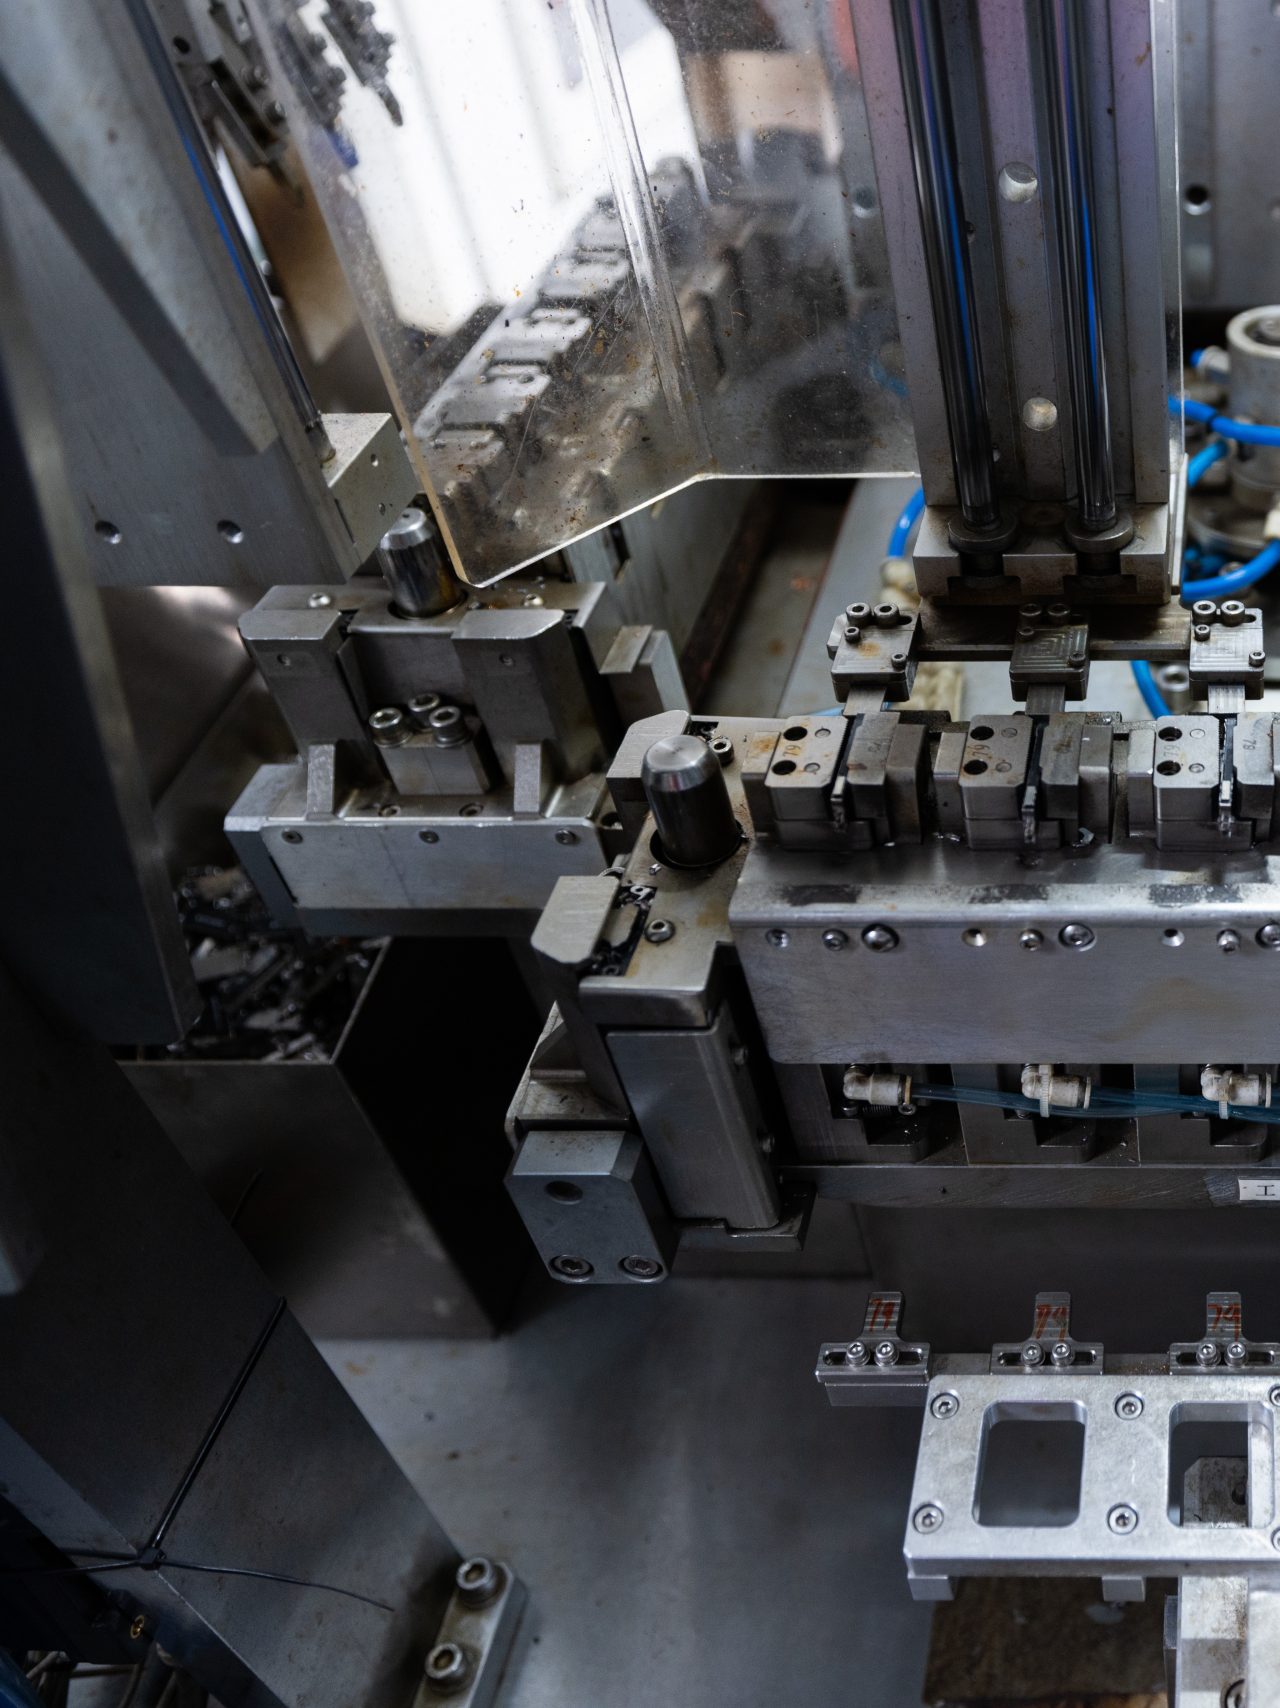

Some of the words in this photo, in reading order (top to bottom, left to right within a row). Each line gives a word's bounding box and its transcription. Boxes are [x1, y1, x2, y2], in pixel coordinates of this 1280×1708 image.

[783, 744, 800, 757] 79
[1243, 738, 1257, 751] 78
[1207, 1303, 1240, 1342] 79
